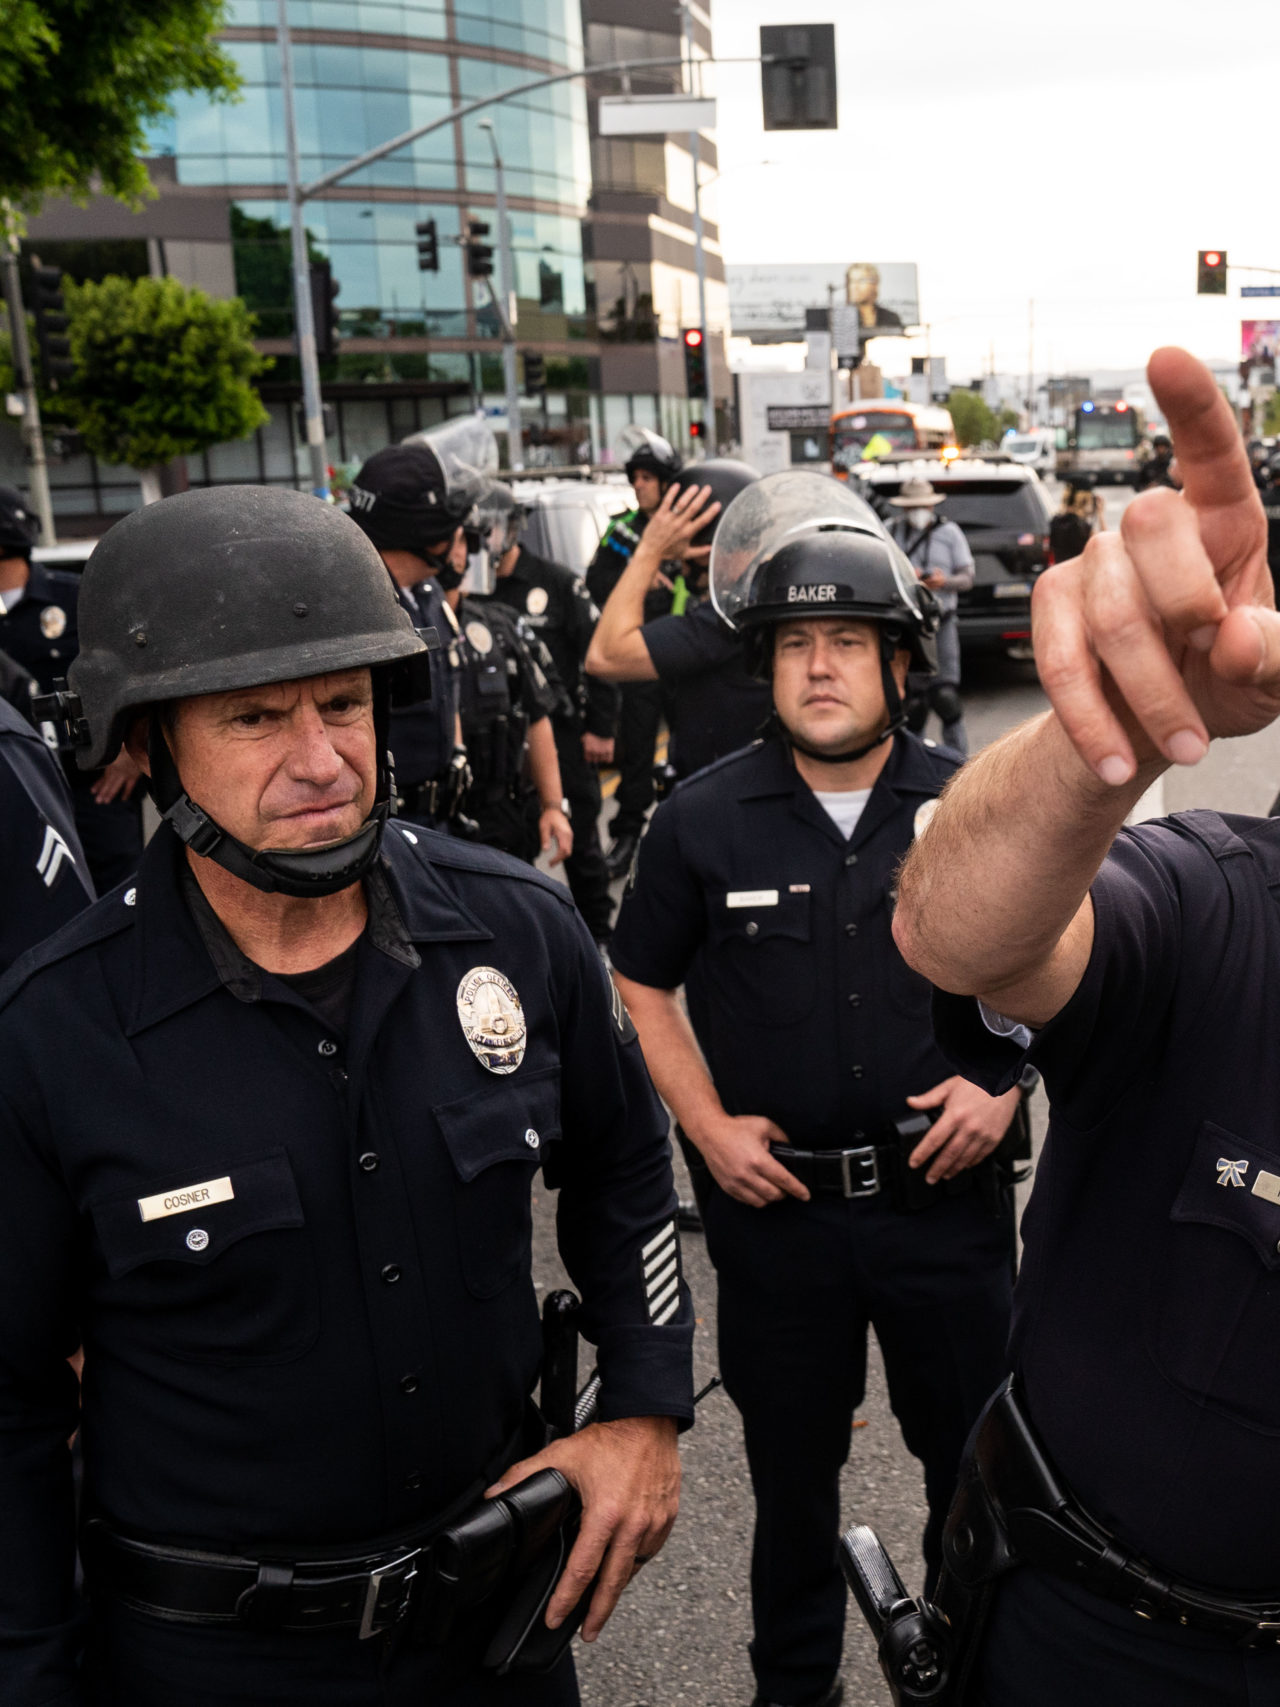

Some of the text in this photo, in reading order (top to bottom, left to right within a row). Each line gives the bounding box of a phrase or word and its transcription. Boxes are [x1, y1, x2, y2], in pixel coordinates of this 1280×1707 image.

[787, 584, 837, 603] BAKER
[464, 975, 485, 1003] POLICE
[163, 1188, 210, 1210] COSNER
